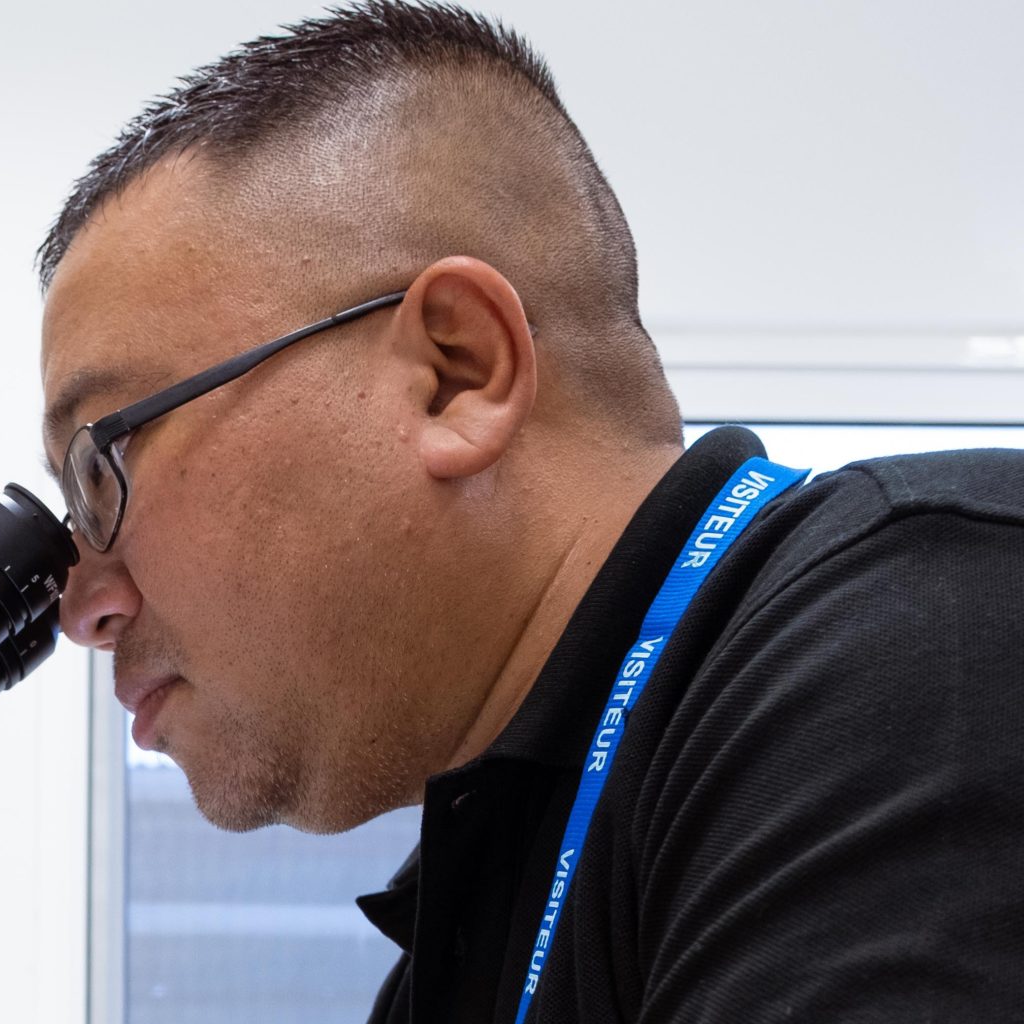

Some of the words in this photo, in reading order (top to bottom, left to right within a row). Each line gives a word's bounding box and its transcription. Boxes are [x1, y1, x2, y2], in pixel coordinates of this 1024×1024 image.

[680, 470, 776, 569] VISITEUR
[587, 636, 664, 773] VISITEUR
[525, 849, 576, 996] VISITEUR
